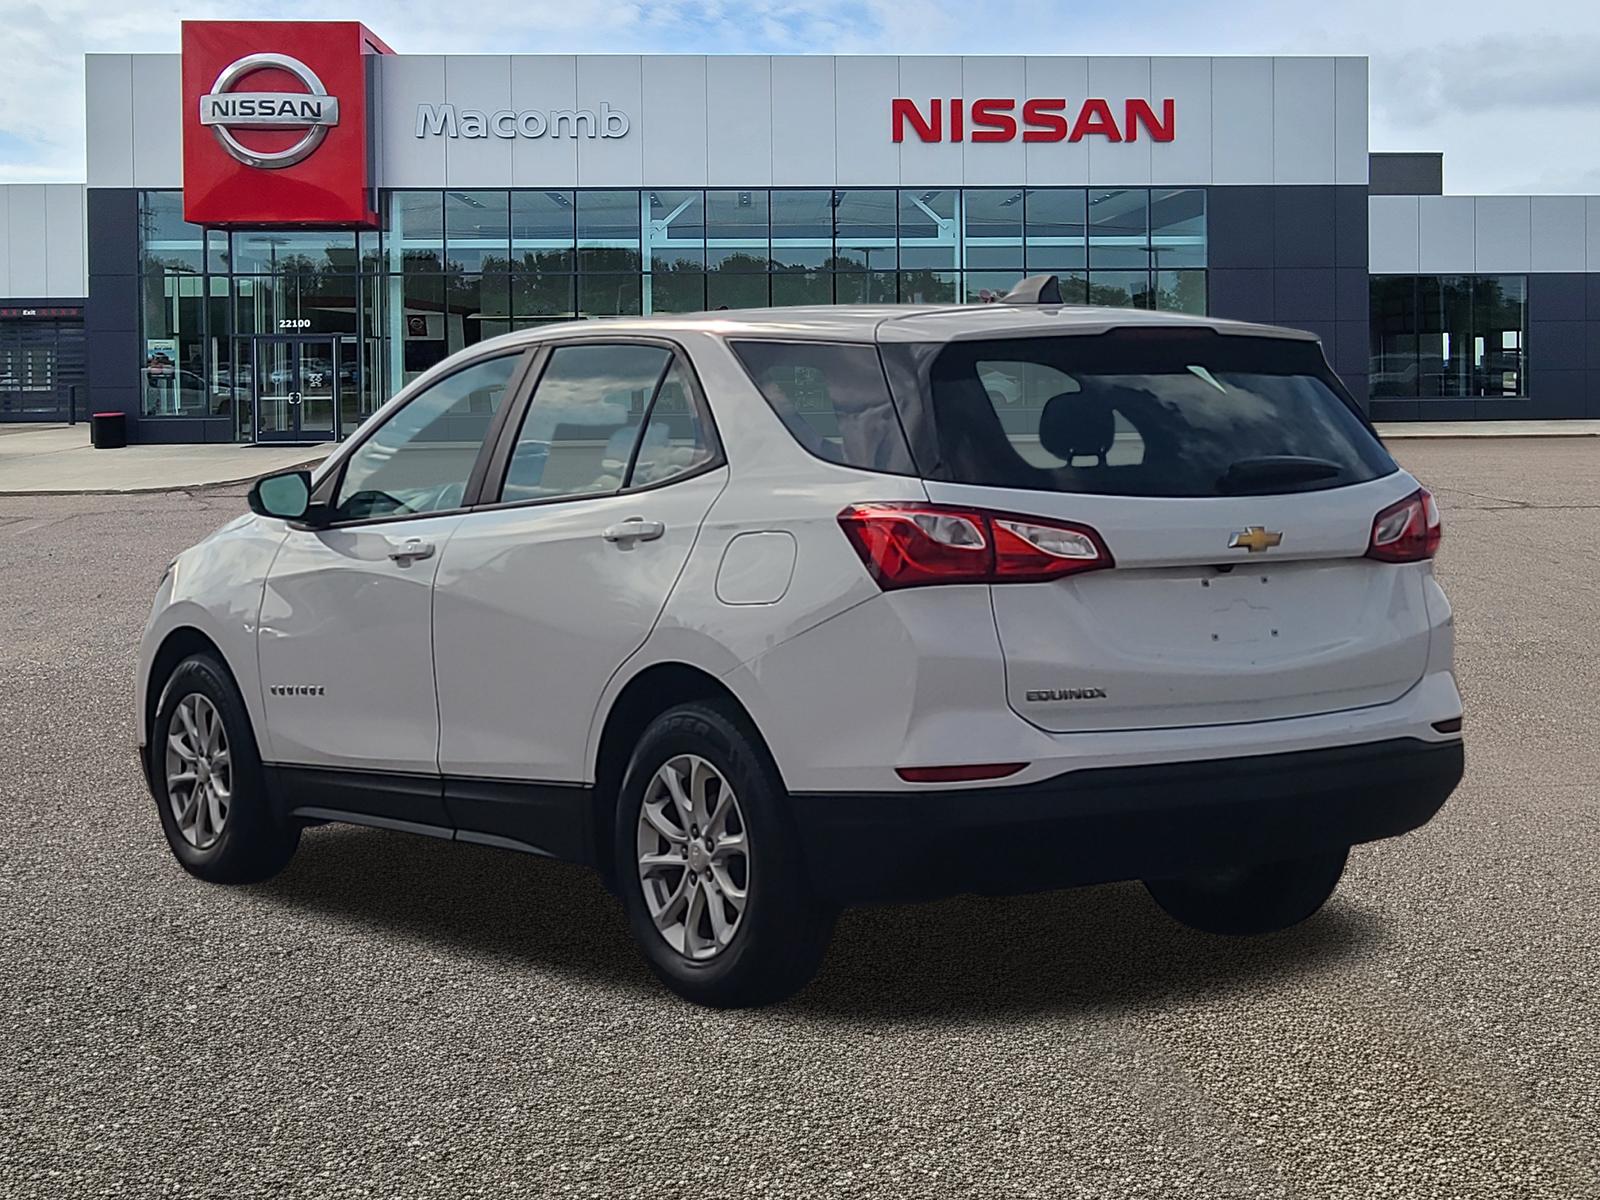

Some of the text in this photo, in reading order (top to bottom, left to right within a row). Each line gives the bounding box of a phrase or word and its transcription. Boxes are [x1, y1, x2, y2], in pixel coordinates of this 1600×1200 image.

[211, 100, 322, 118] NISSAN
[415, 102, 630, 139] Macomb
[892, 98, 1175, 142] NISSAN
[279, 319, 311, 328] 22100
[1026, 688, 1107, 702] EQUINOX
